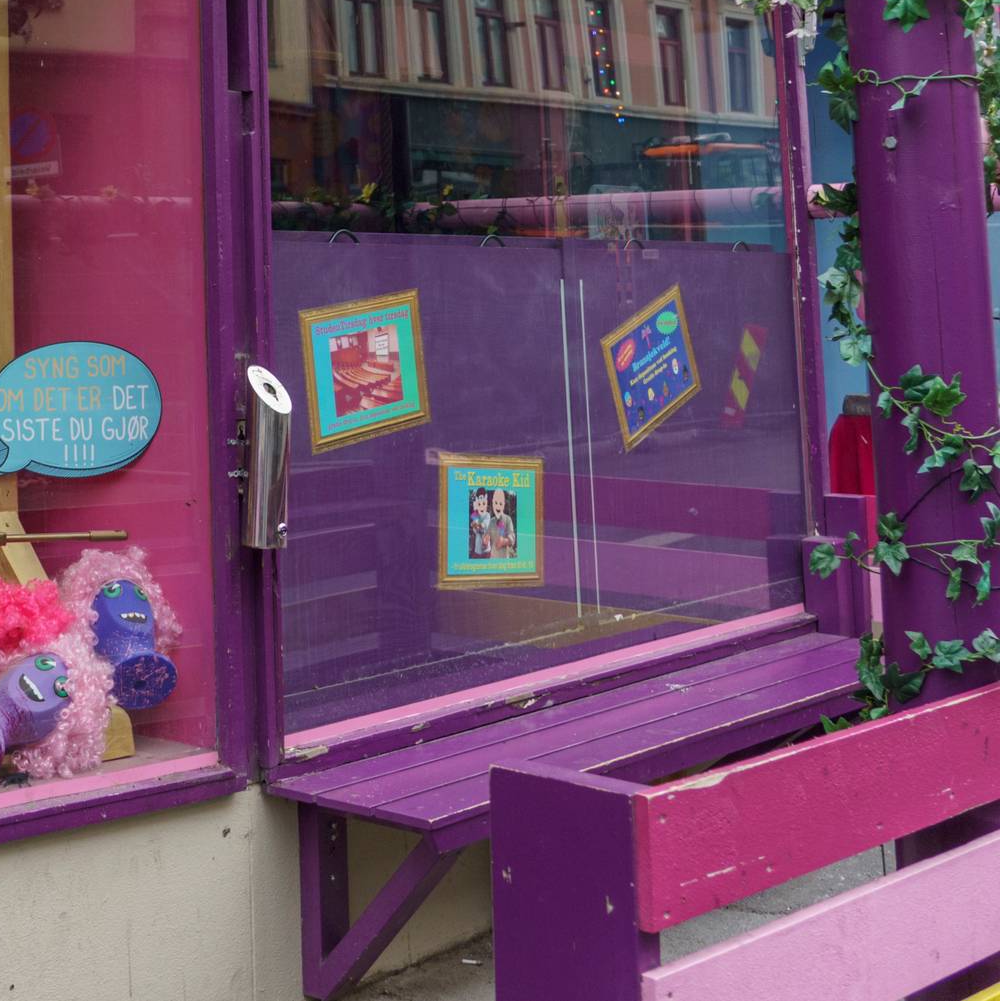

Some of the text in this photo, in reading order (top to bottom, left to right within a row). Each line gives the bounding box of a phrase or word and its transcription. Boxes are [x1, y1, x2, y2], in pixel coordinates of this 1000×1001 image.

[24, 354, 126, 380] SYNG SOM
[33, 386, 72, 412] DET
[77, 386, 101, 411] ER
[112, 384, 149, 411] DET
[1, 416, 150, 442] SISTE DU GJØR
[467, 471, 511, 488] Karaoke
[512, 472, 531, 488] Kid
